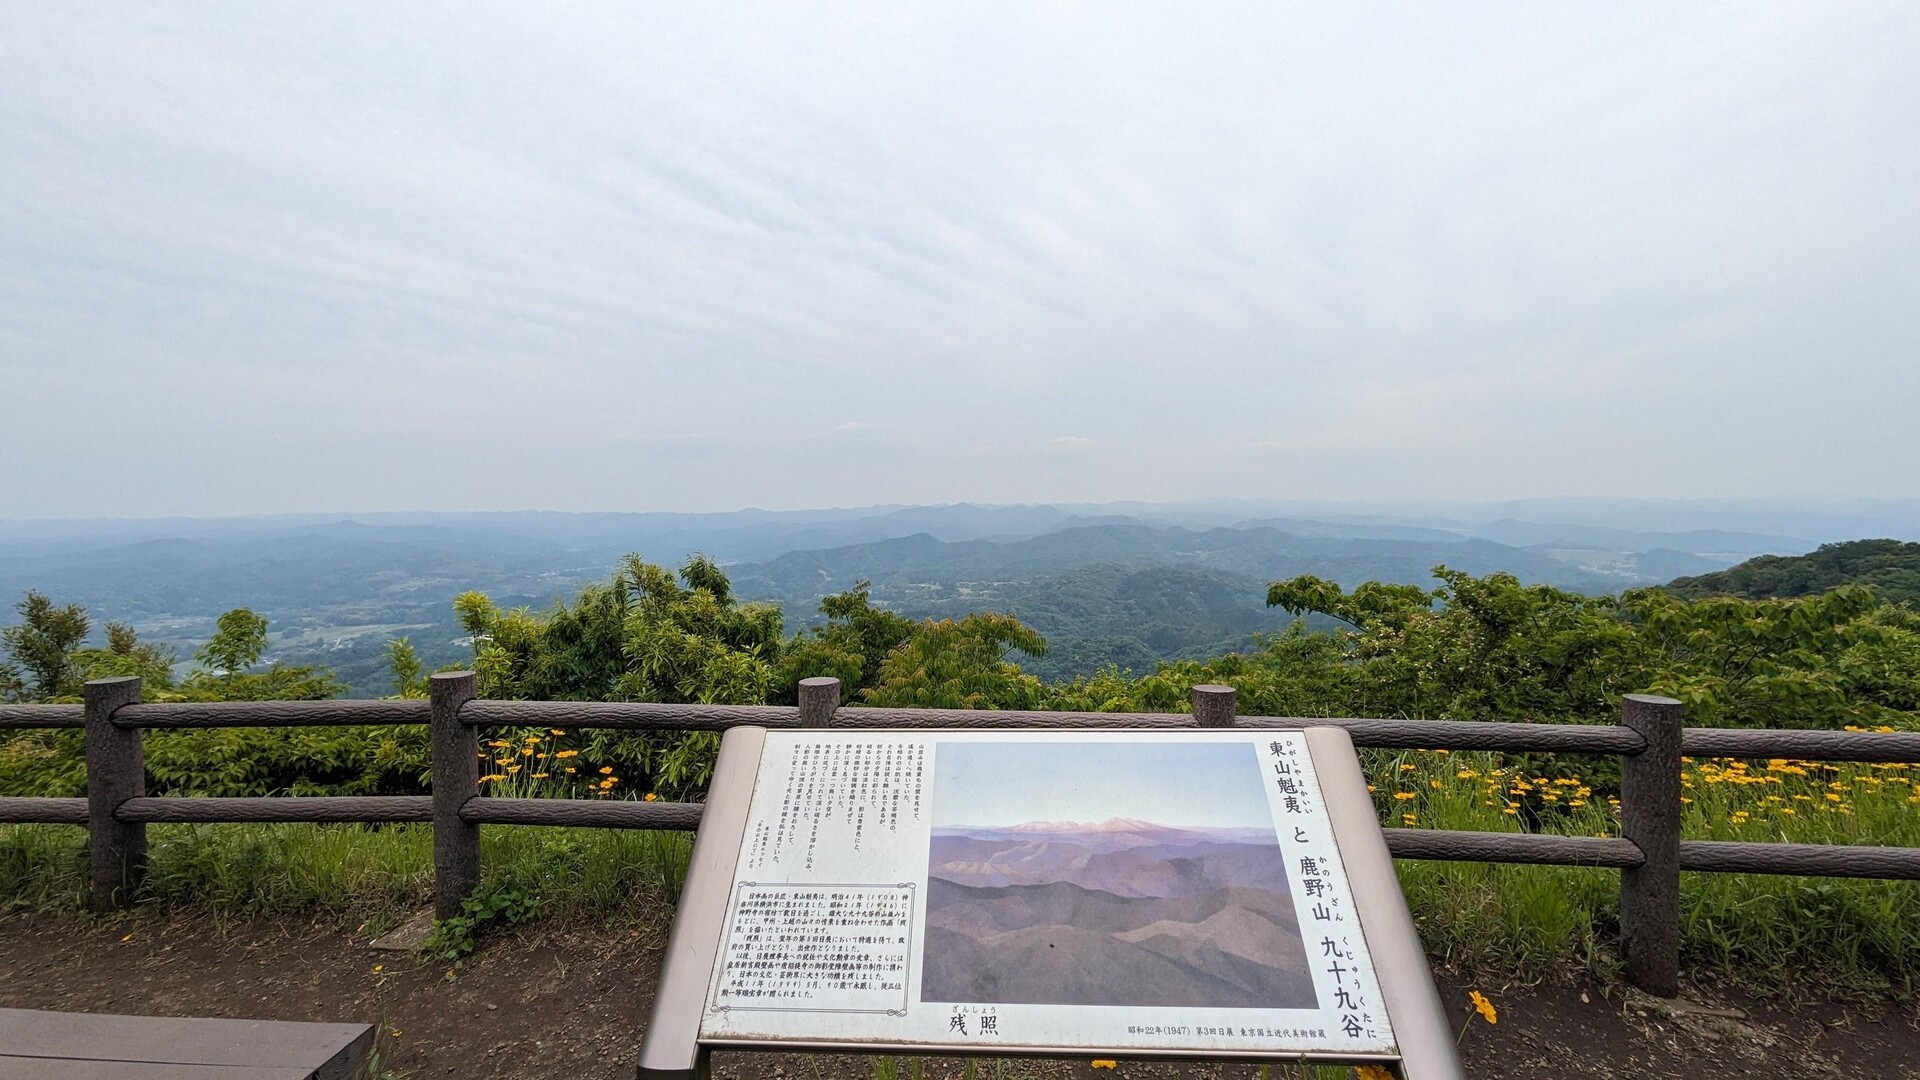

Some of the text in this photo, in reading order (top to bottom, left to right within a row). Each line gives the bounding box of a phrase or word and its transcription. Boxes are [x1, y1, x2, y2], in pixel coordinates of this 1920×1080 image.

[1286, 740, 1313, 815] ひがしやまかいい
[1269, 742, 1363, 1039] 東山魁夷 と 鹿野山 九十九谷
[1319, 856, 1344, 922] かのうざん
[952, 1006, 997, 1014] ざんしょう
[1343, 936, 1376, 1039] くじゅうくたに
[949, 1014, 999, 1036] 残照
[1128, 1026, 1327, 1039] 昭和22年(1947) 第3回日展 東京国立近代美術館蔵
